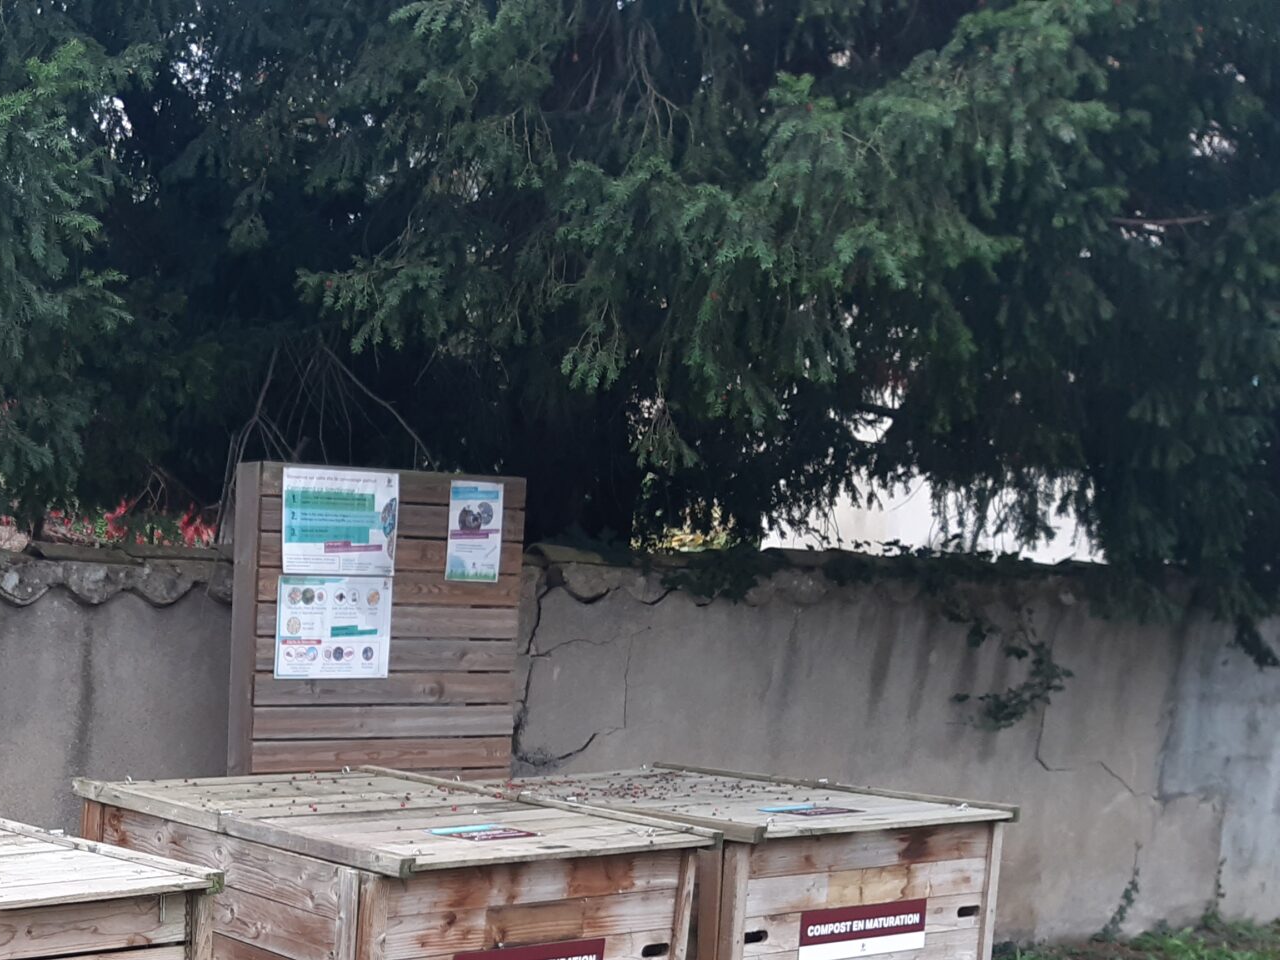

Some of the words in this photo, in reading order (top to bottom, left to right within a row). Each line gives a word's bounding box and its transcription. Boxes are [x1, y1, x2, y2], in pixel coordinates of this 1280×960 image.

[807, 921, 851, 937] COMPOST
[852, 919, 865, 931] EN
[865, 913, 920, 929] MATURATION
